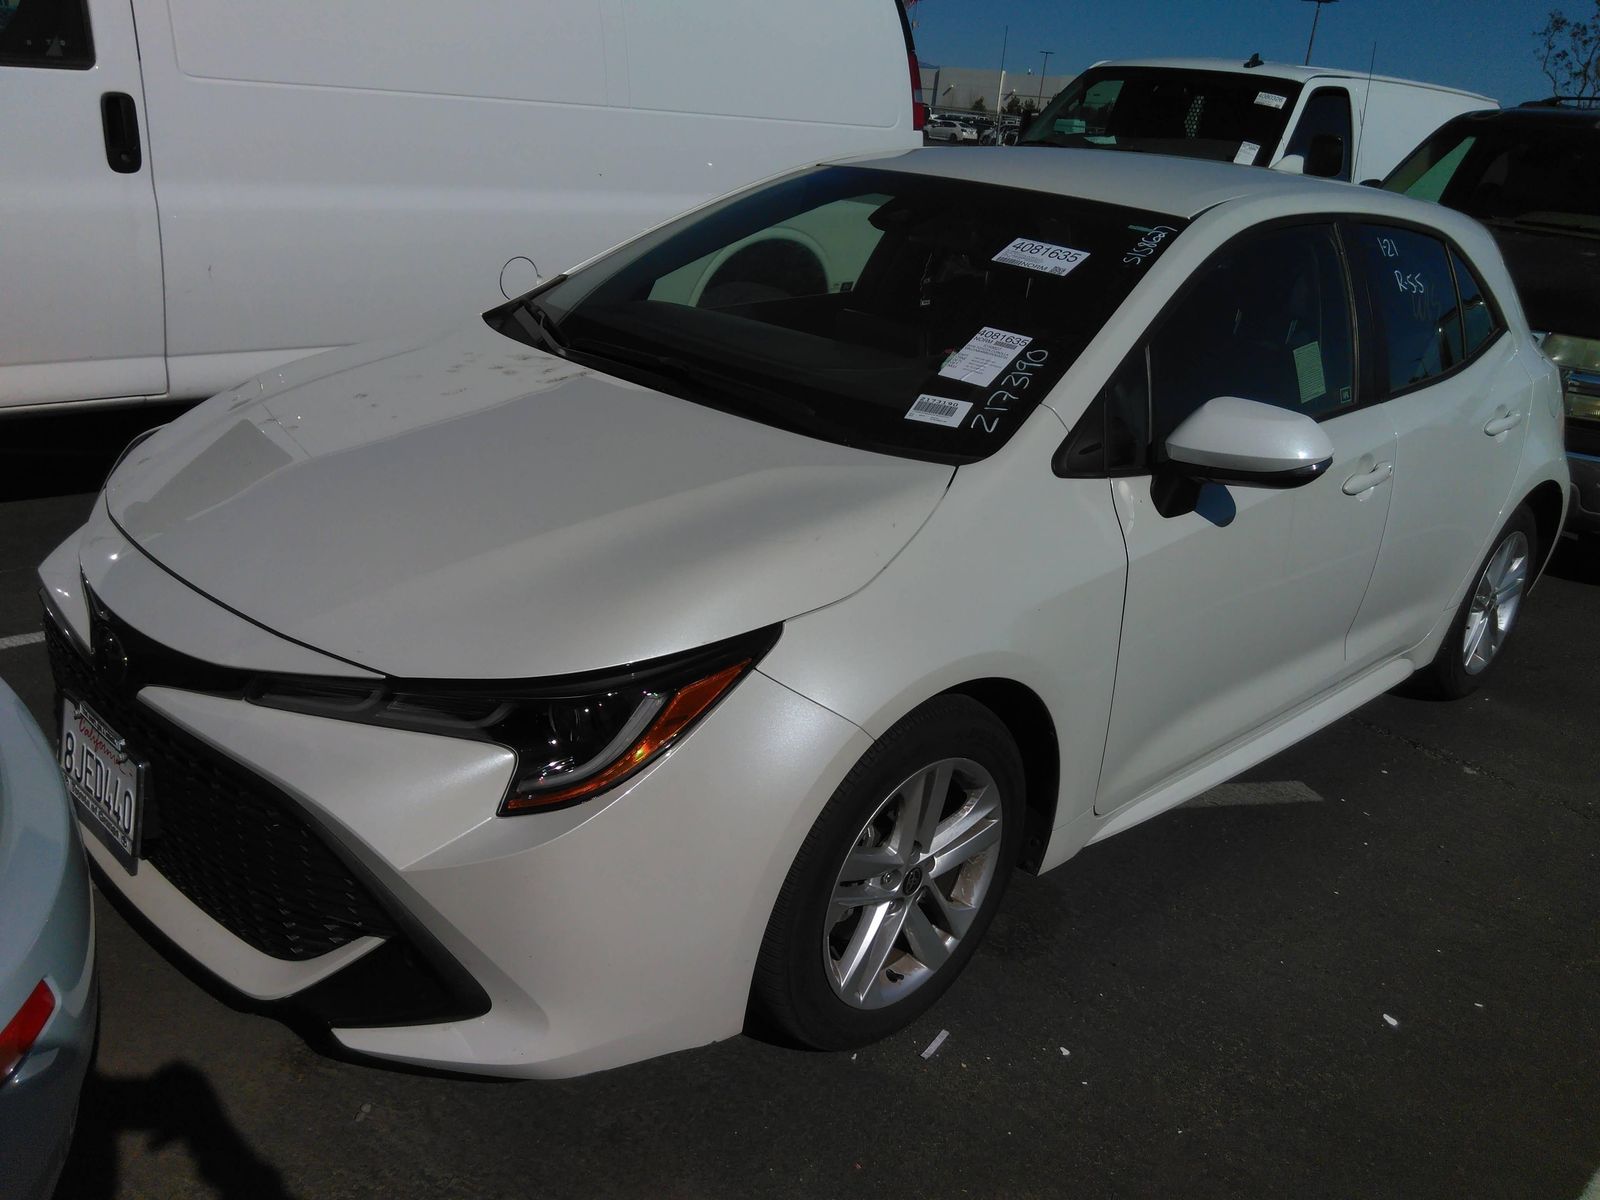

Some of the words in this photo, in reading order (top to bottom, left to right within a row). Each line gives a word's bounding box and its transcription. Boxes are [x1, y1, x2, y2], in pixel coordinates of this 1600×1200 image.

[1011, 240, 1082, 263] 4081635
[978, 329, 1030, 347] 4081635
[970, 348, 1049, 433] 2173190
[63, 730, 136, 836] 8JED440
